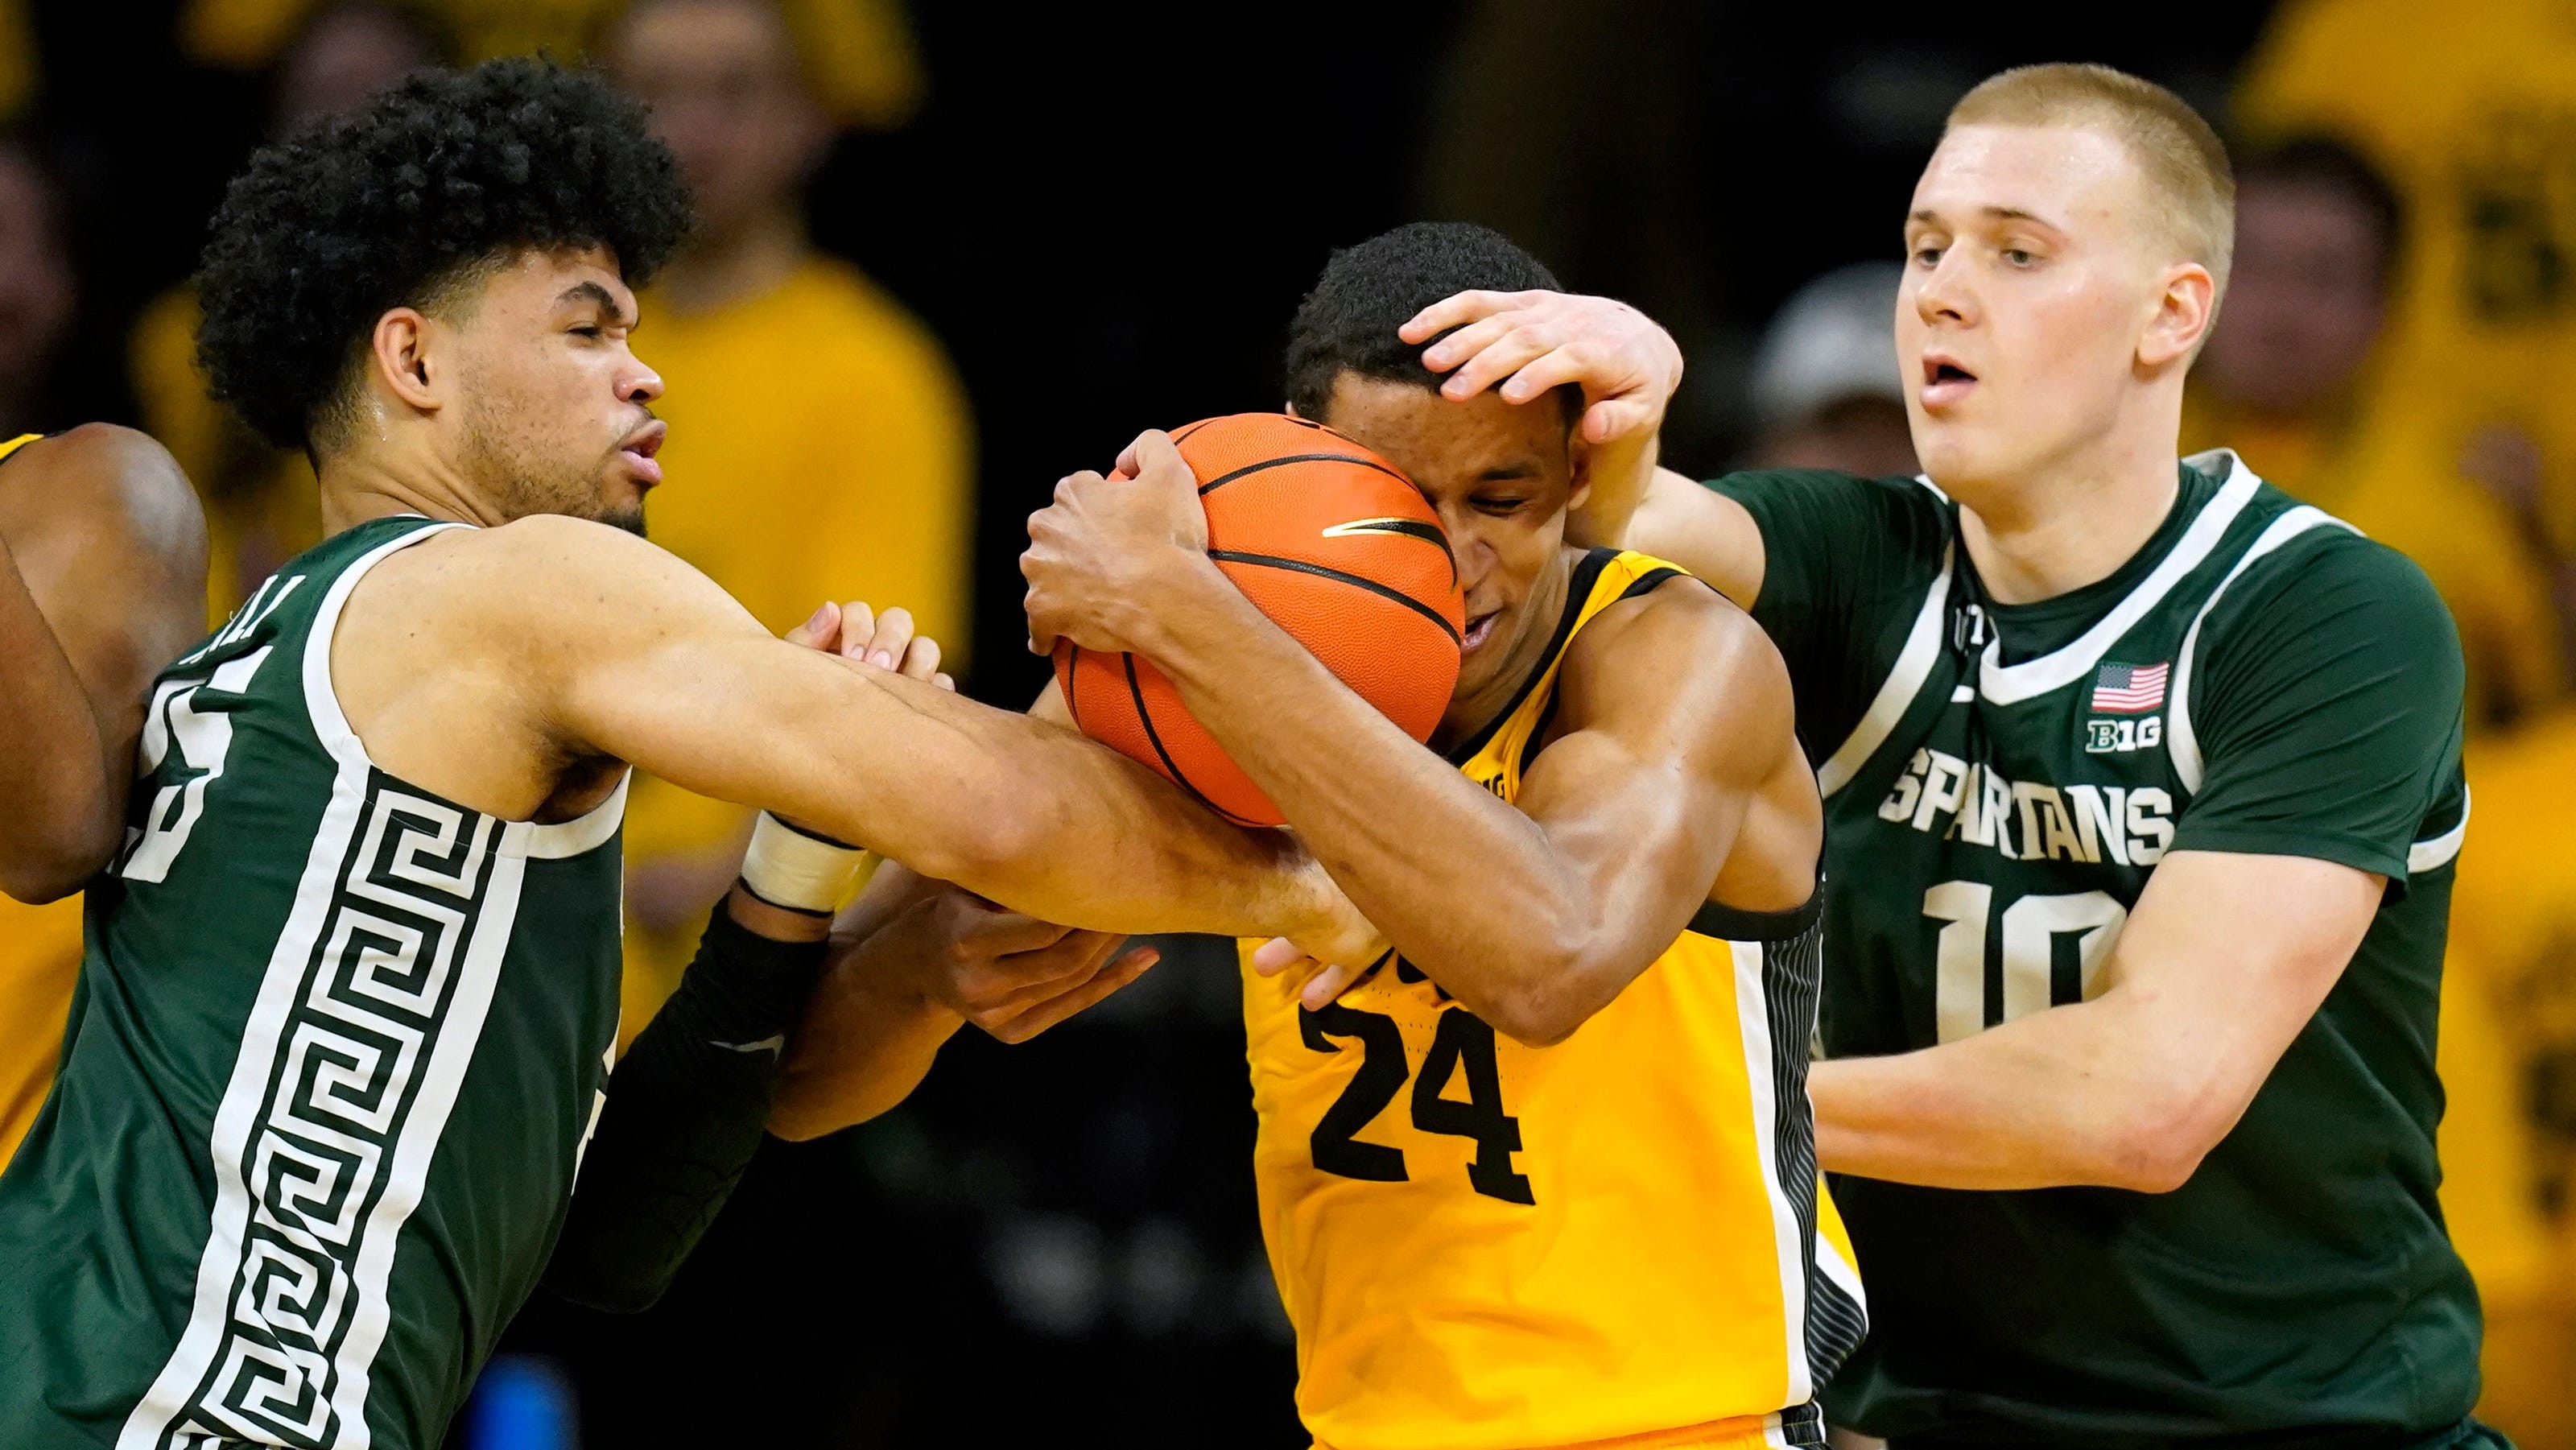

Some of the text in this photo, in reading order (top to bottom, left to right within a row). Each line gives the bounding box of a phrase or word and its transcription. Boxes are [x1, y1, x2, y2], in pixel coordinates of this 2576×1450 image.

[1878, 746, 2174, 866] SPARTANS
[1922, 879, 2127, 1047] 10
[1298, 999, 1536, 1206] 24
